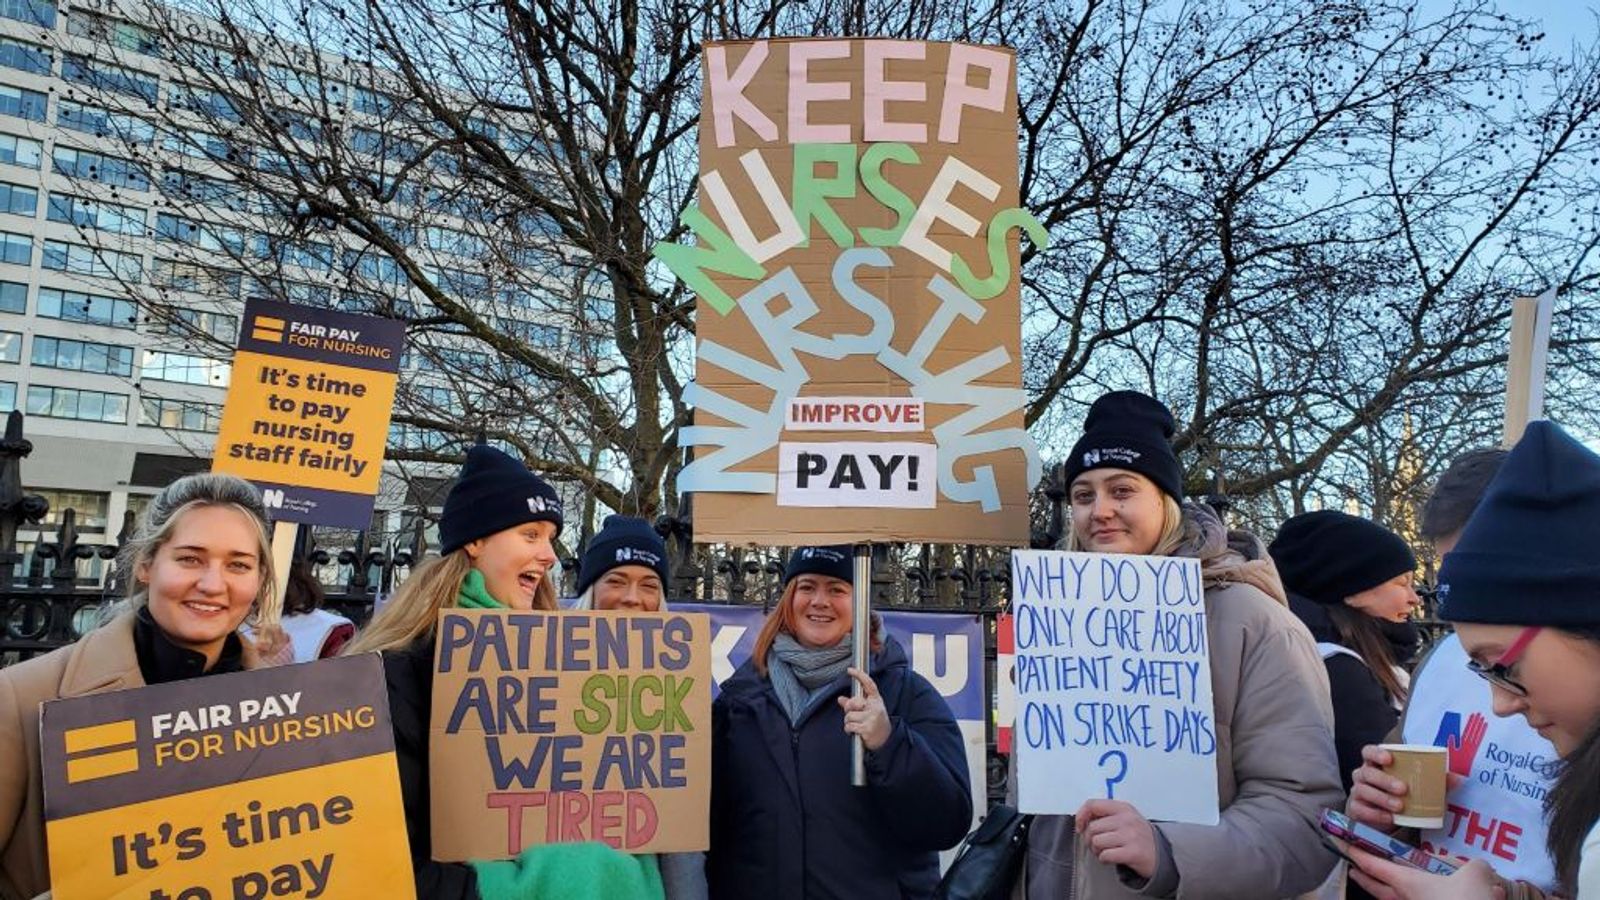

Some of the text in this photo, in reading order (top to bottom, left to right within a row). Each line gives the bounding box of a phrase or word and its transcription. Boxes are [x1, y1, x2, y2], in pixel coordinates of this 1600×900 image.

[706, 39, 1011, 148] KEEP
[651, 142, 1049, 317] NURSES
[288, 334, 392, 360] FOR NURSING
[290, 321, 361, 342] FAIR PAY
[260, 366, 367, 398] It's time
[268, 394, 351, 424] to pay
[791, 403, 921, 424] IMPROVE
[228, 442, 368, 478] staff fairly
[252, 420, 355, 451] nursing
[795, 453, 921, 491] PAY!
[1014, 555, 1201, 606] WHY DO YOU
[438, 614, 694, 673] PATIENTS
[1016, 603, 1207, 656] ONLY CARE ABOUT
[445, 673, 695, 735] ARE SICK
[1017, 654, 1200, 704] PATIENT SAFETY
[152, 692, 302, 738] FAIR PAY
[154, 705, 376, 767] FOR NURSING
[1024, 702, 1216, 755] ON STRIKE DAYS
[485, 734, 688, 792] WE ARE
[1480, 769, 1500, 786] of
[1485, 742, 1531, 771] Royal
[112, 795, 354, 876] It's time
[486, 790, 660, 856] TIRED
[1447, 804, 1524, 862] THE
[232, 853, 335, 900] pay
